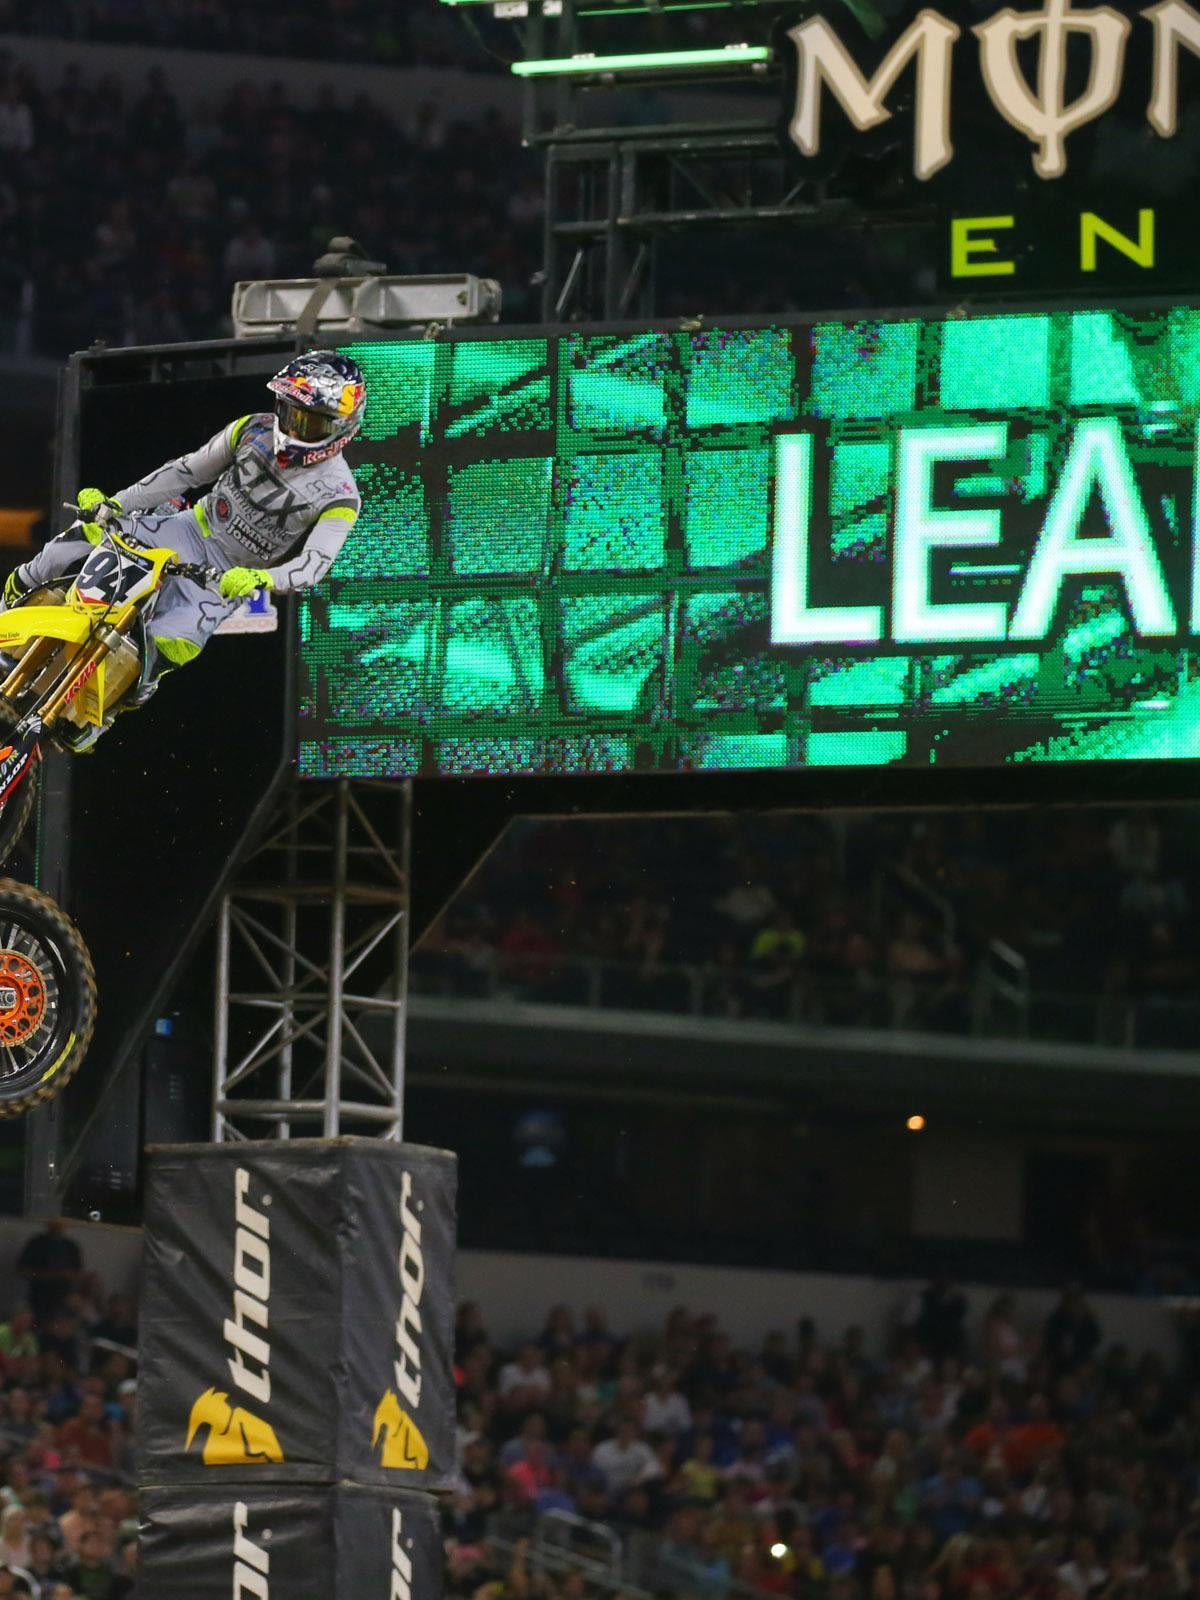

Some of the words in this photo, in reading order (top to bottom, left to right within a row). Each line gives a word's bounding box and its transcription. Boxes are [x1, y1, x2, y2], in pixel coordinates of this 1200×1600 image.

[232, 515, 277, 555] JIMMY
[771, 418, 1200, 643] LEA
[76, 551, 149, 603] 94
